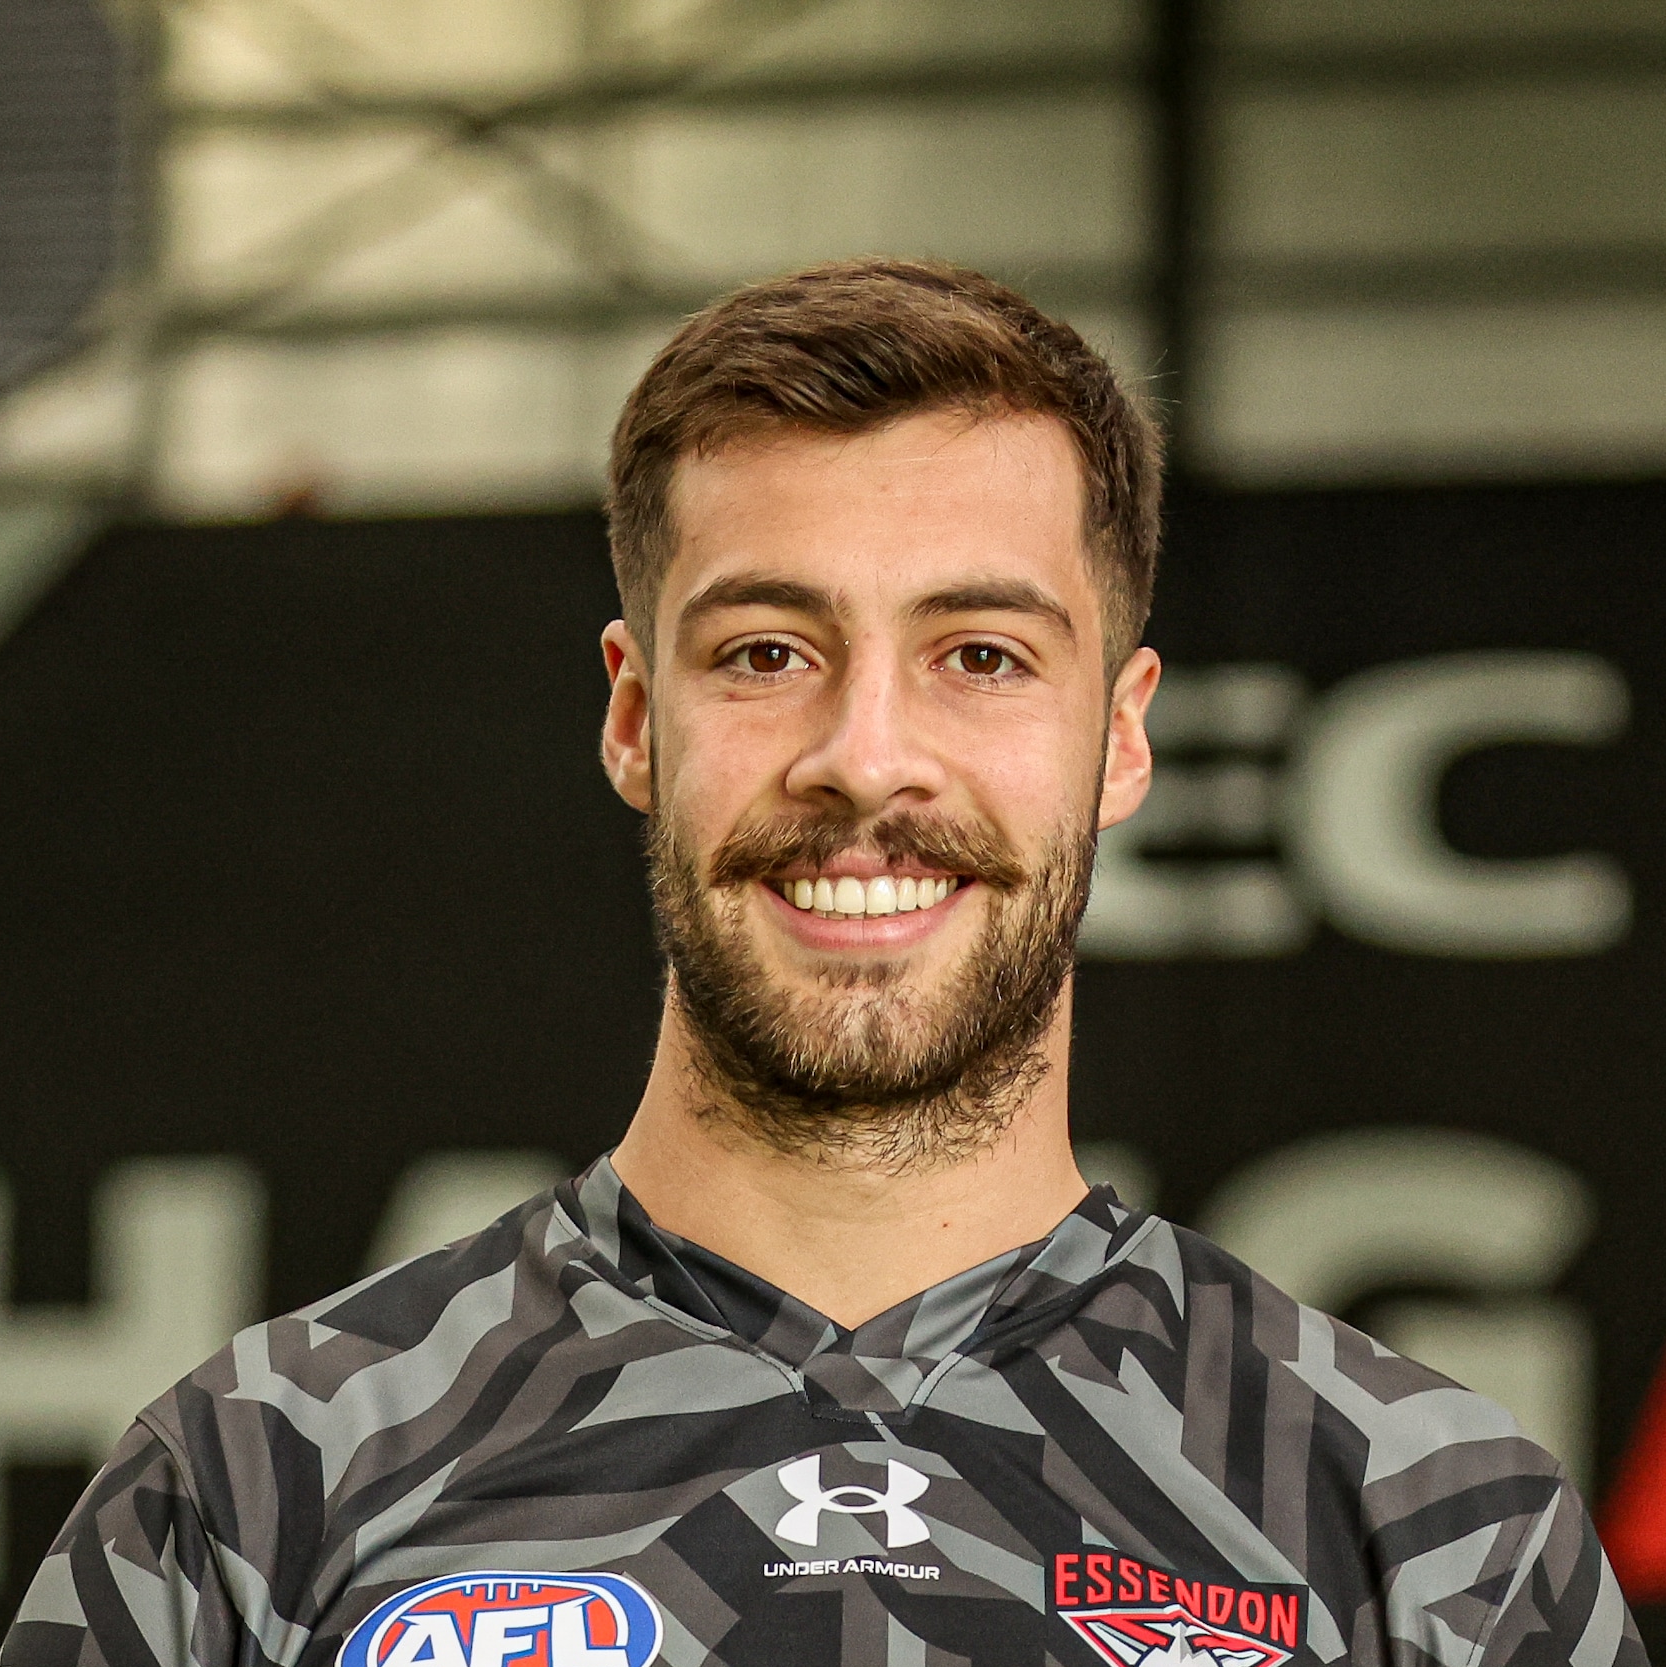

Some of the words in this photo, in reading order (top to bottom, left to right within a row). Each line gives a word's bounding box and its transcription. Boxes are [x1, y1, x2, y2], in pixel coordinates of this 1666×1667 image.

[763, 1560, 839, 1577] UNDER
[842, 1559, 940, 1580] ARMOUR
[1055, 1553, 1299, 1649] ESSENDON
